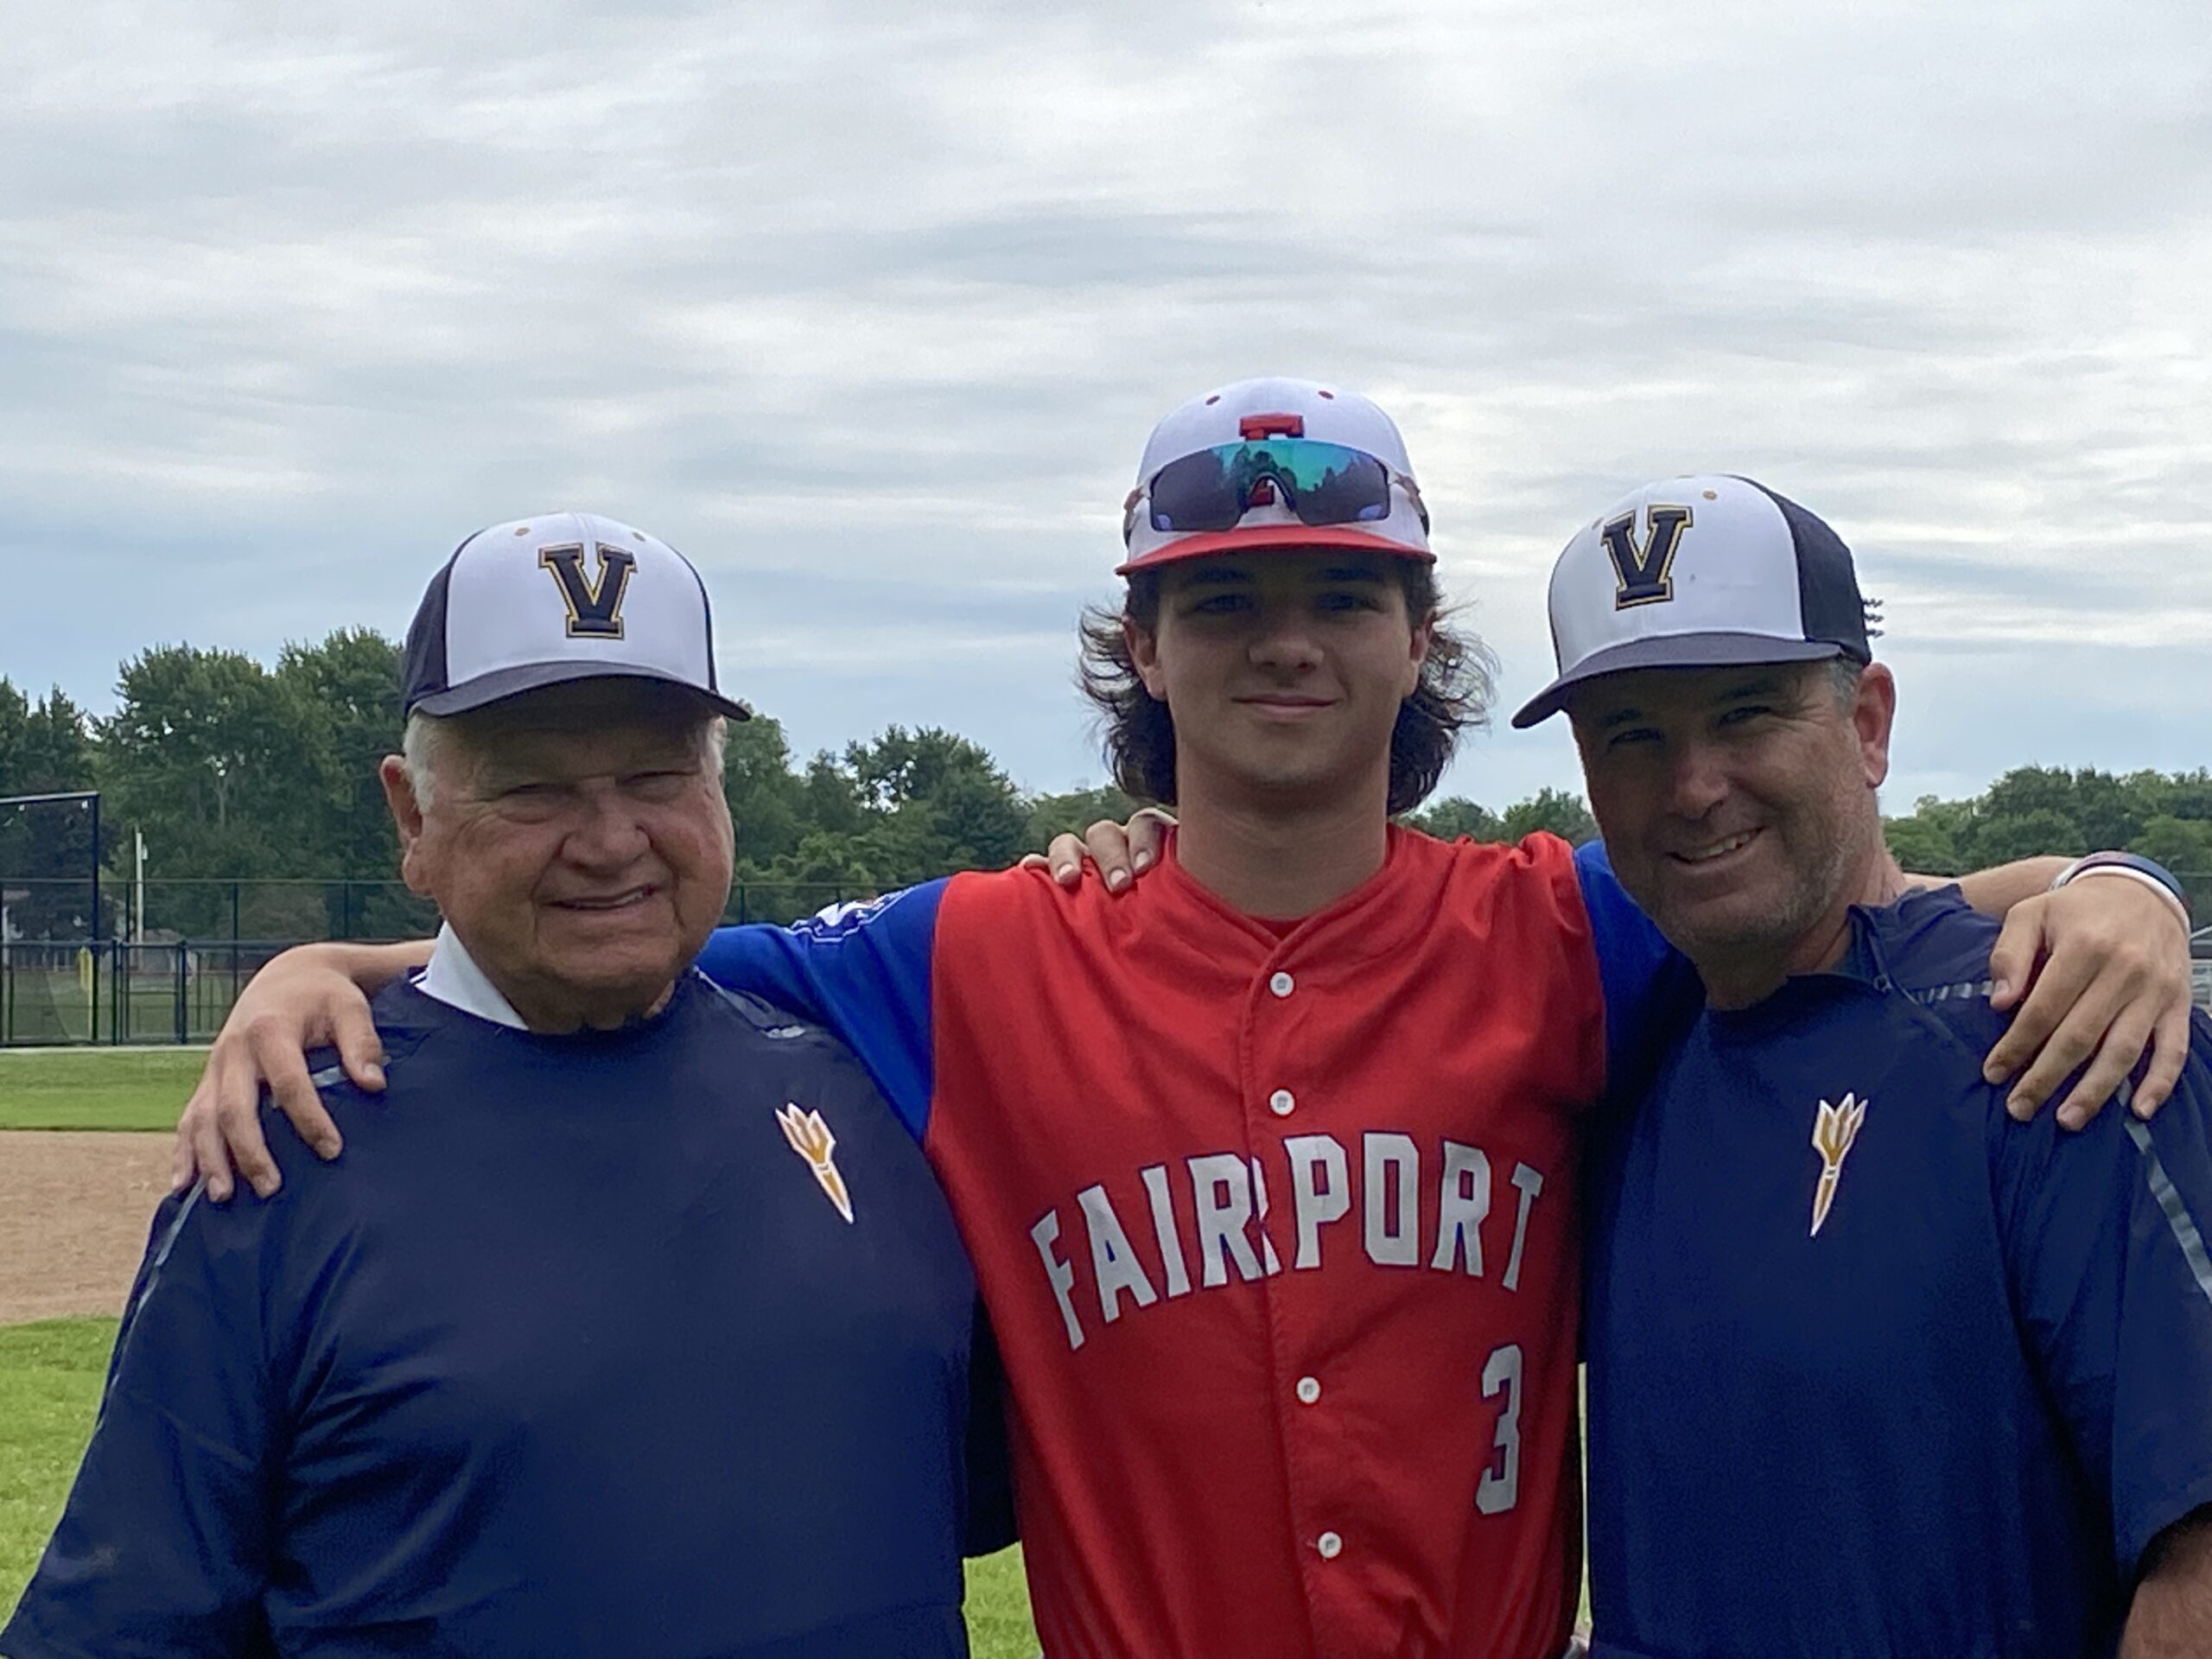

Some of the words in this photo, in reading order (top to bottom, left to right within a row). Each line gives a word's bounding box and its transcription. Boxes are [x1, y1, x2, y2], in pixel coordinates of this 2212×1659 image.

[537, 541, 639, 640] V
[1600, 504, 1694, 612] V
[1029, 1130, 1545, 1351] FAIRPORT
[1475, 1343, 1523, 1516] 3
